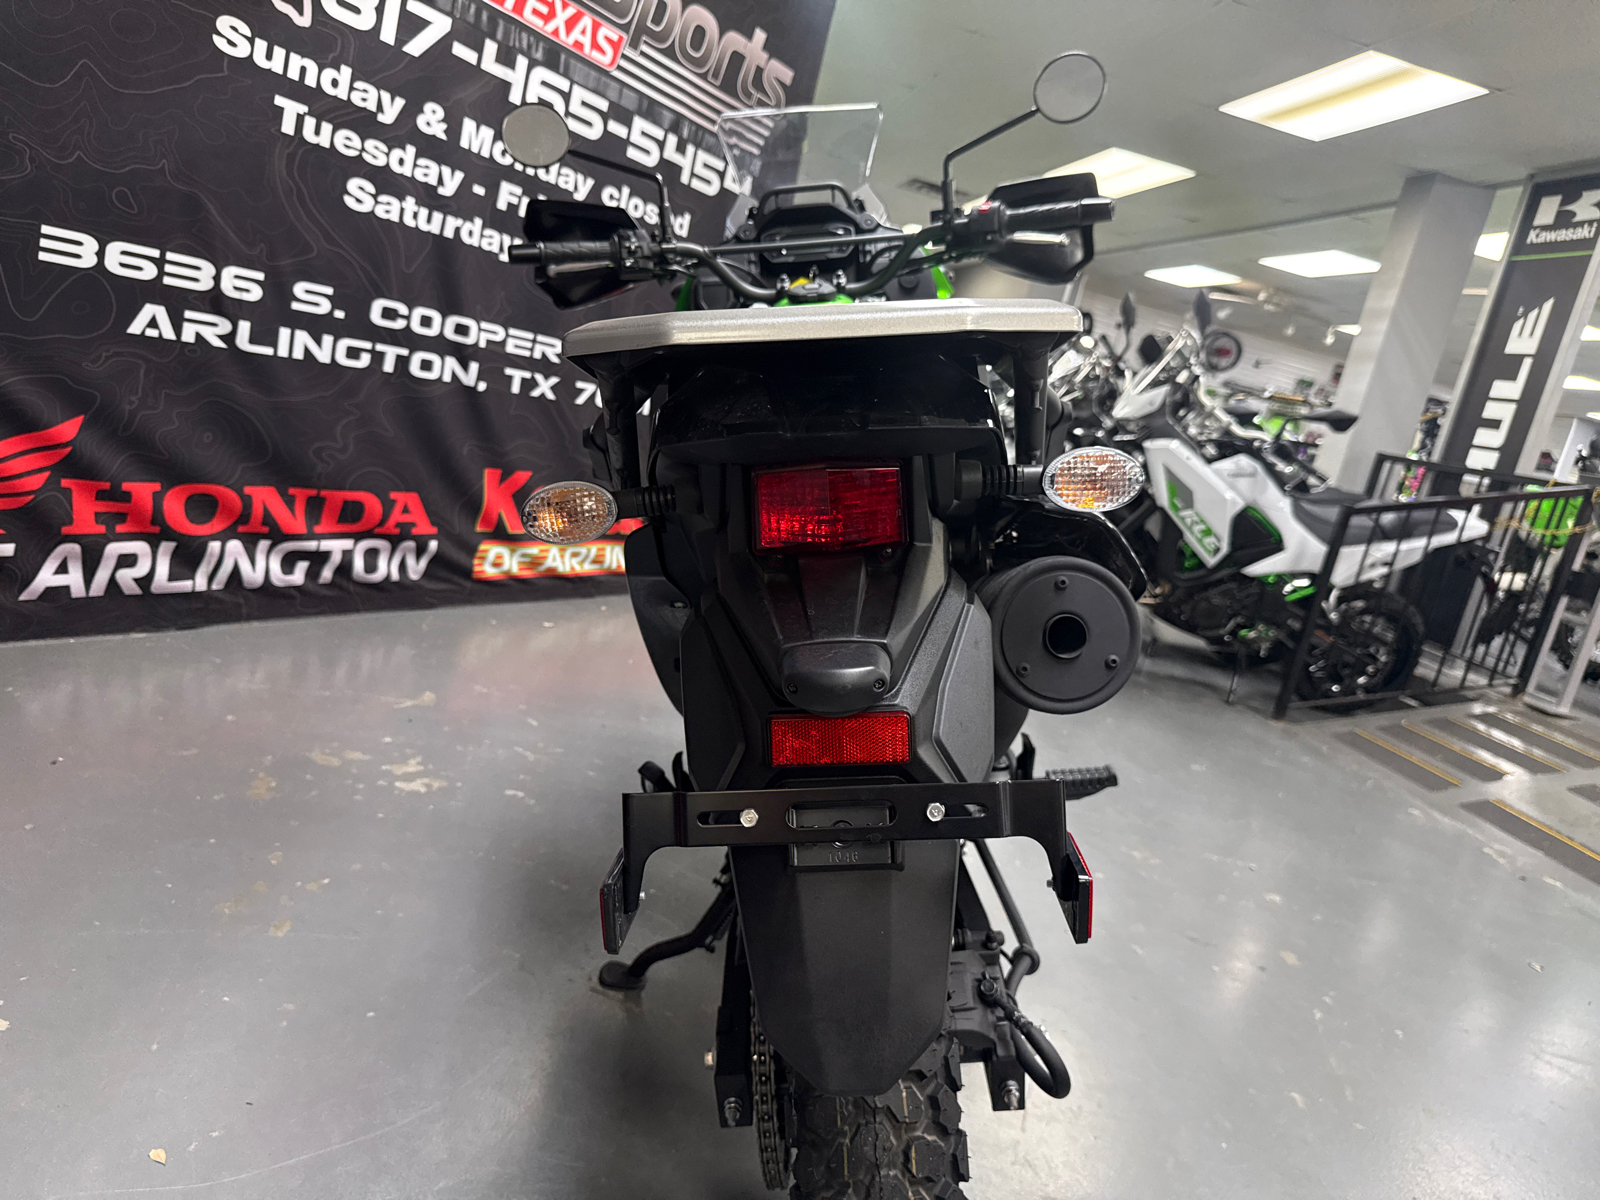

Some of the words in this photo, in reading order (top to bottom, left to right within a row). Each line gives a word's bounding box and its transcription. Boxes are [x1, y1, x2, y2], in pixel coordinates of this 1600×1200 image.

[212, 15, 406, 124] Sunday
[416, 101, 448, 141] &
[601, 185, 691, 238] closd
[274, 94, 465, 196] Tuesday
[343, 177, 523, 262] Saturday
[1526, 221, 1598, 245] Kawasaki
[37, 224, 266, 302] 3636
[290, 281, 346, 320] S.
[369, 298, 562, 364] COOPER
[126, 303, 487, 392] ARLINGTON,
[504, 367, 560, 401] TX
[60, 478, 439, 536] HONDA
[18, 538, 439, 600] ARLINGTON
[483, 546, 539, 574] OF
